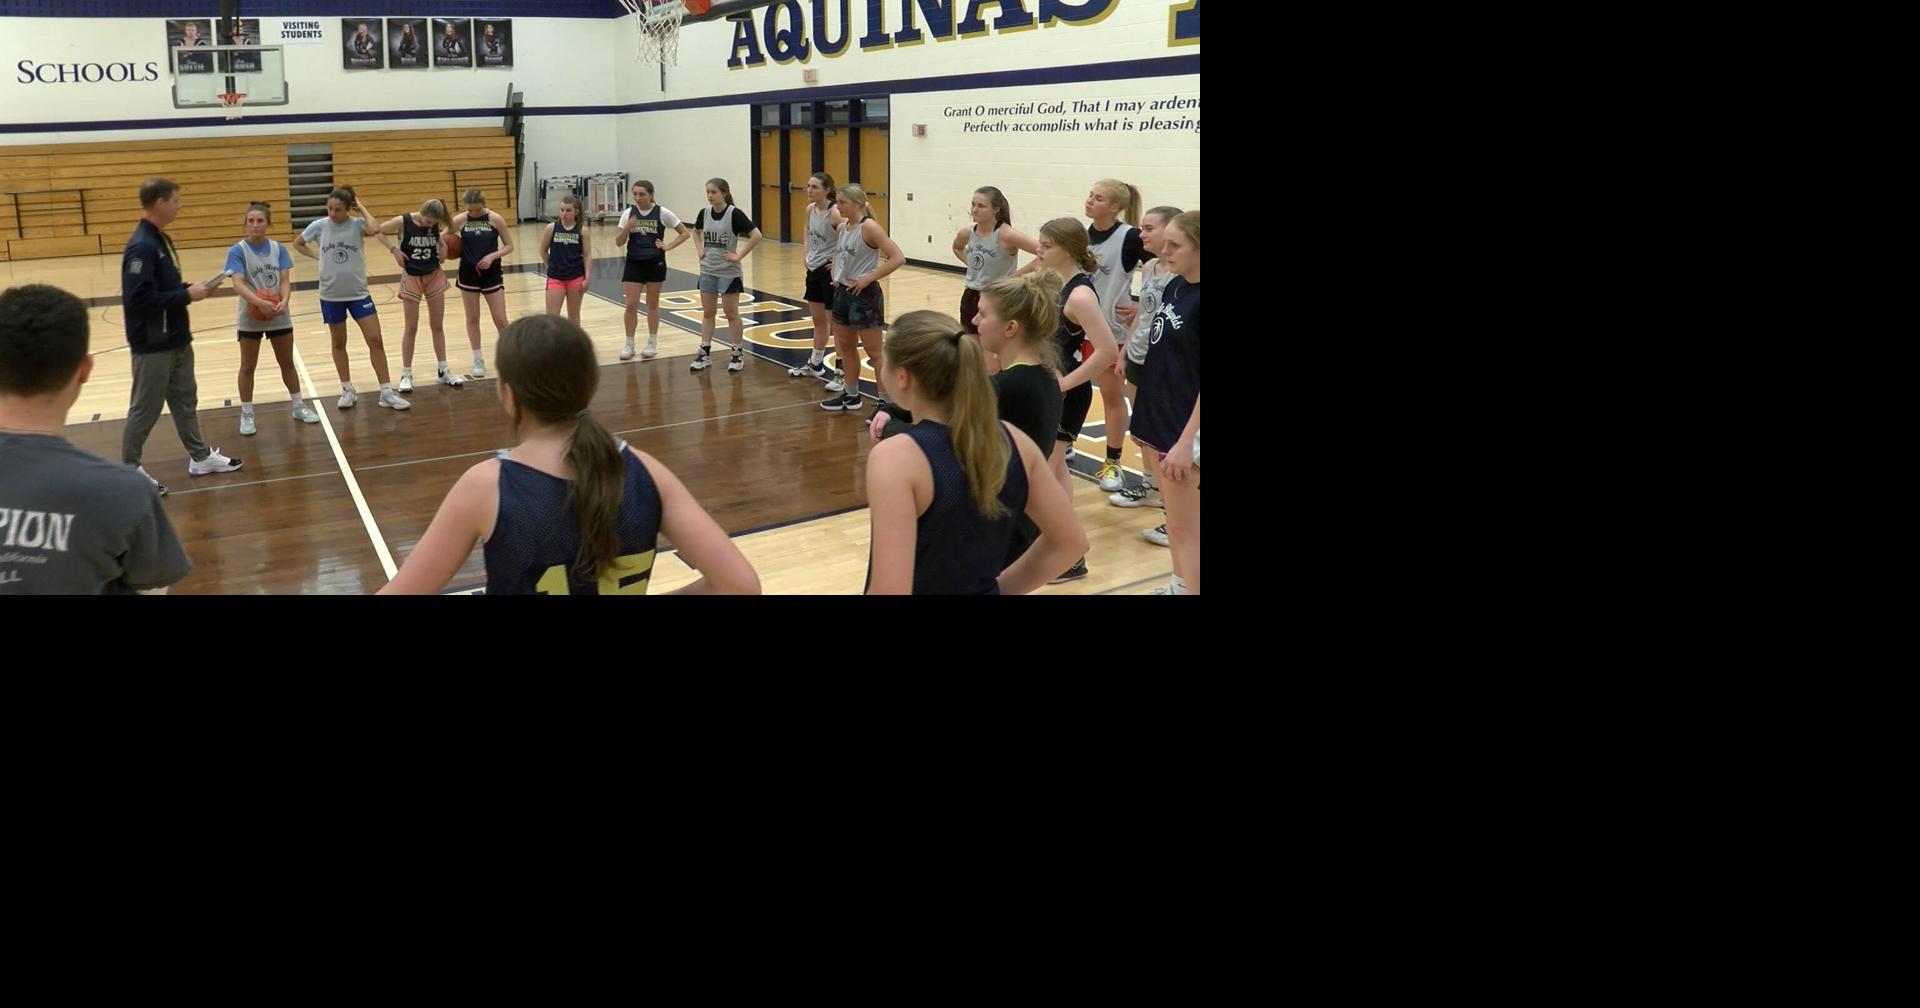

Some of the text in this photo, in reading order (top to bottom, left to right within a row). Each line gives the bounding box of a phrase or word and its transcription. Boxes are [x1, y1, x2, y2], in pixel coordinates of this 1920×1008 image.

[282, 21, 320, 30] VISITING
[280, 30, 322, 39] STUDENTS
[727, 0, 1120, 71] AQUIN
[17, 60, 159, 84] SCHOOLS
[943, 95, 1200, 117] Grant O merciful God, That I may arden
[963, 121, 1009, 132] Perfectly
[1012, 118, 1080, 133] accomplish
[1084, 118, 1119, 131] what
[1122, 117, 1134, 131] is
[410, 248, 432, 260] 23
